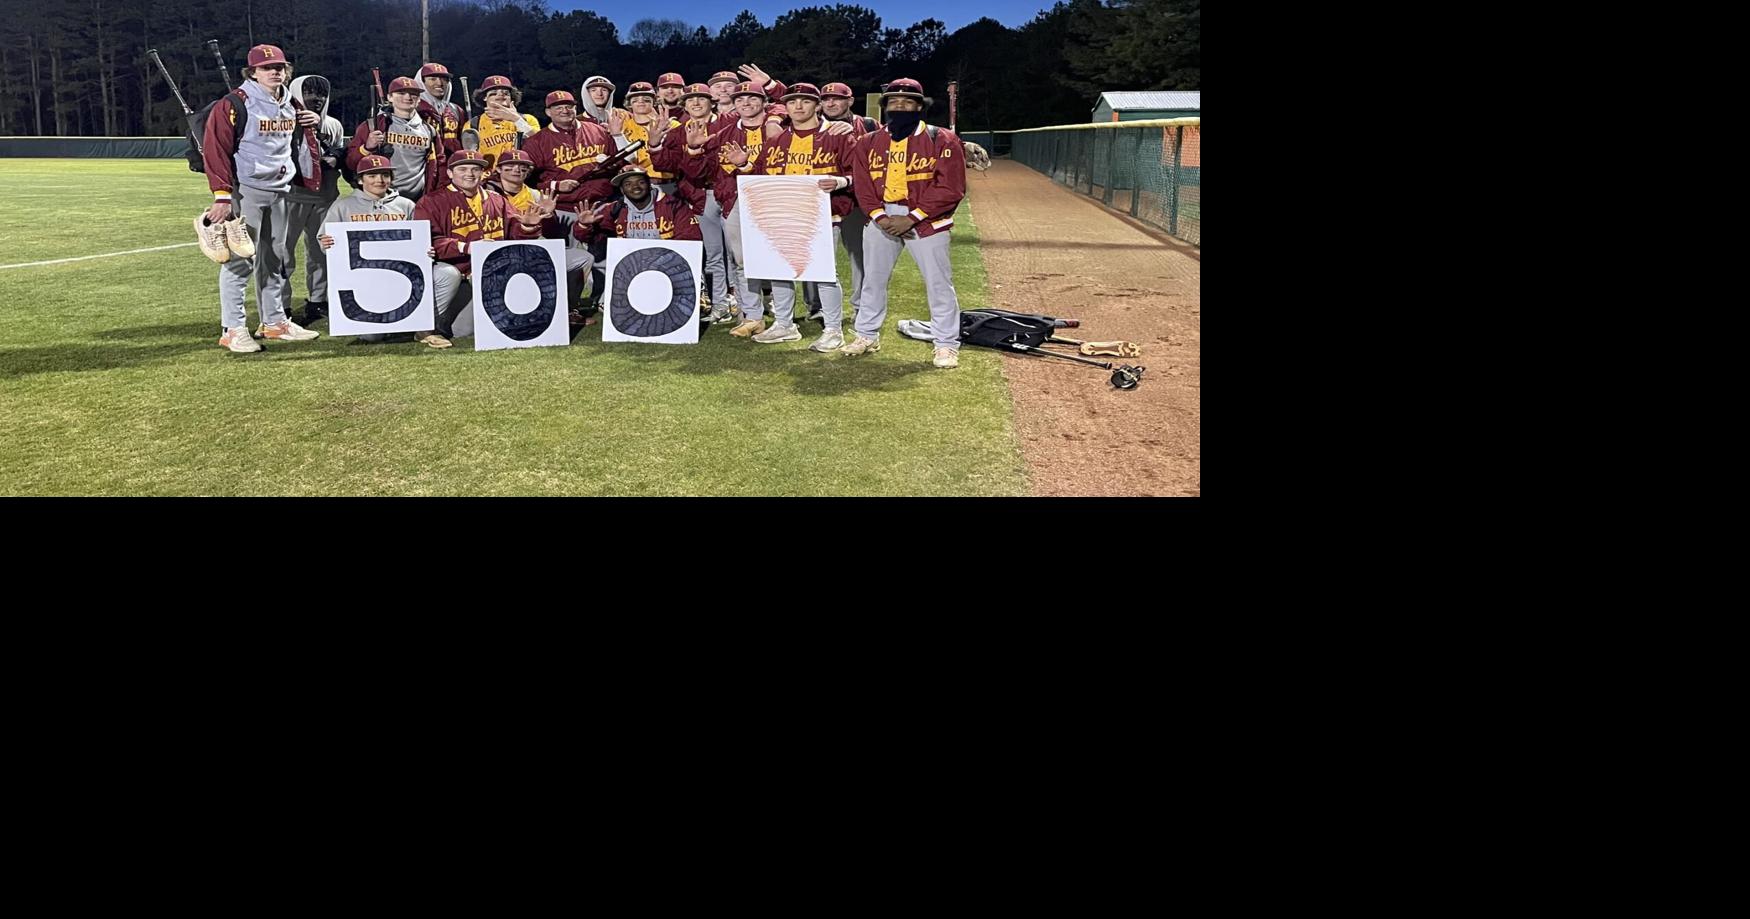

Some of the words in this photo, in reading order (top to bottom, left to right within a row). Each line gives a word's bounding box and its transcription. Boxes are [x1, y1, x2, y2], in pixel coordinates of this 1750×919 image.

[262, 47, 275, 58] H
[434, 64, 442, 72] H
[493, 77, 502, 85] H
[664, 73, 674, 81] H
[402, 79, 412, 87] H
[741, 83, 751, 92] H
[826, 84, 835, 92] H
[557, 91, 565, 99] H
[386, 132, 429, 146] HICKORY
[466, 152, 475, 160] H
[512, 152, 521, 160] H
[371, 157, 382, 167] H
[338, 229, 425, 324] 5
[481, 244, 558, 341] 0
[610, 246, 697, 337] 0
